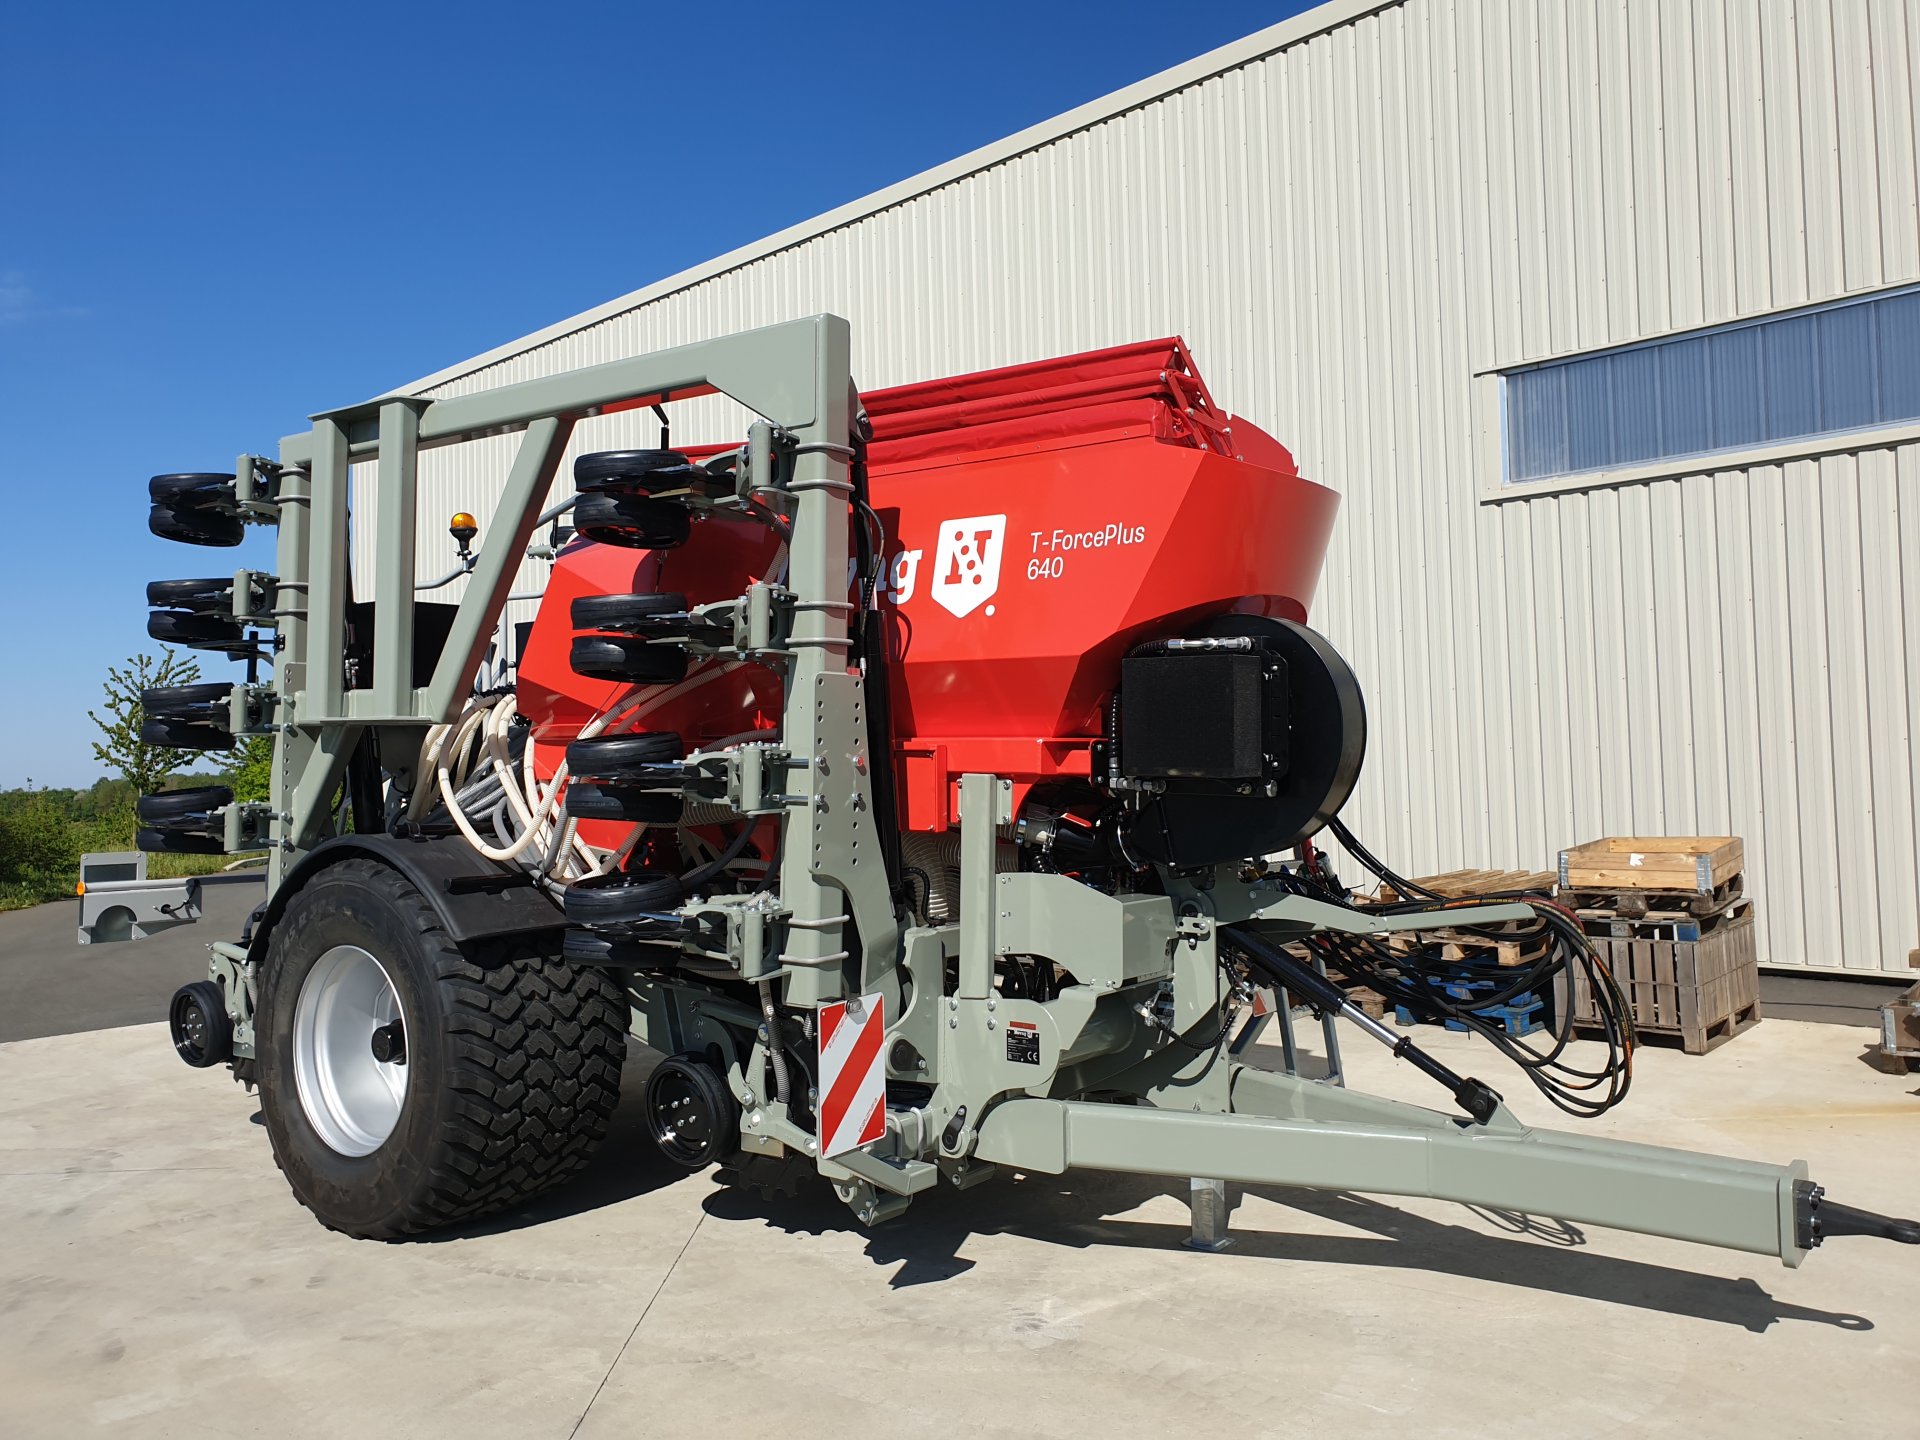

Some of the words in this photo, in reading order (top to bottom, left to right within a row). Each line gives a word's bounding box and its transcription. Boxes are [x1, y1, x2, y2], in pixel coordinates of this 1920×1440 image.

[1031, 523, 1144, 552] T-ForcePlus
[1028, 557, 1063, 579] 640
[1027, 1051, 1038, 1062] CE
